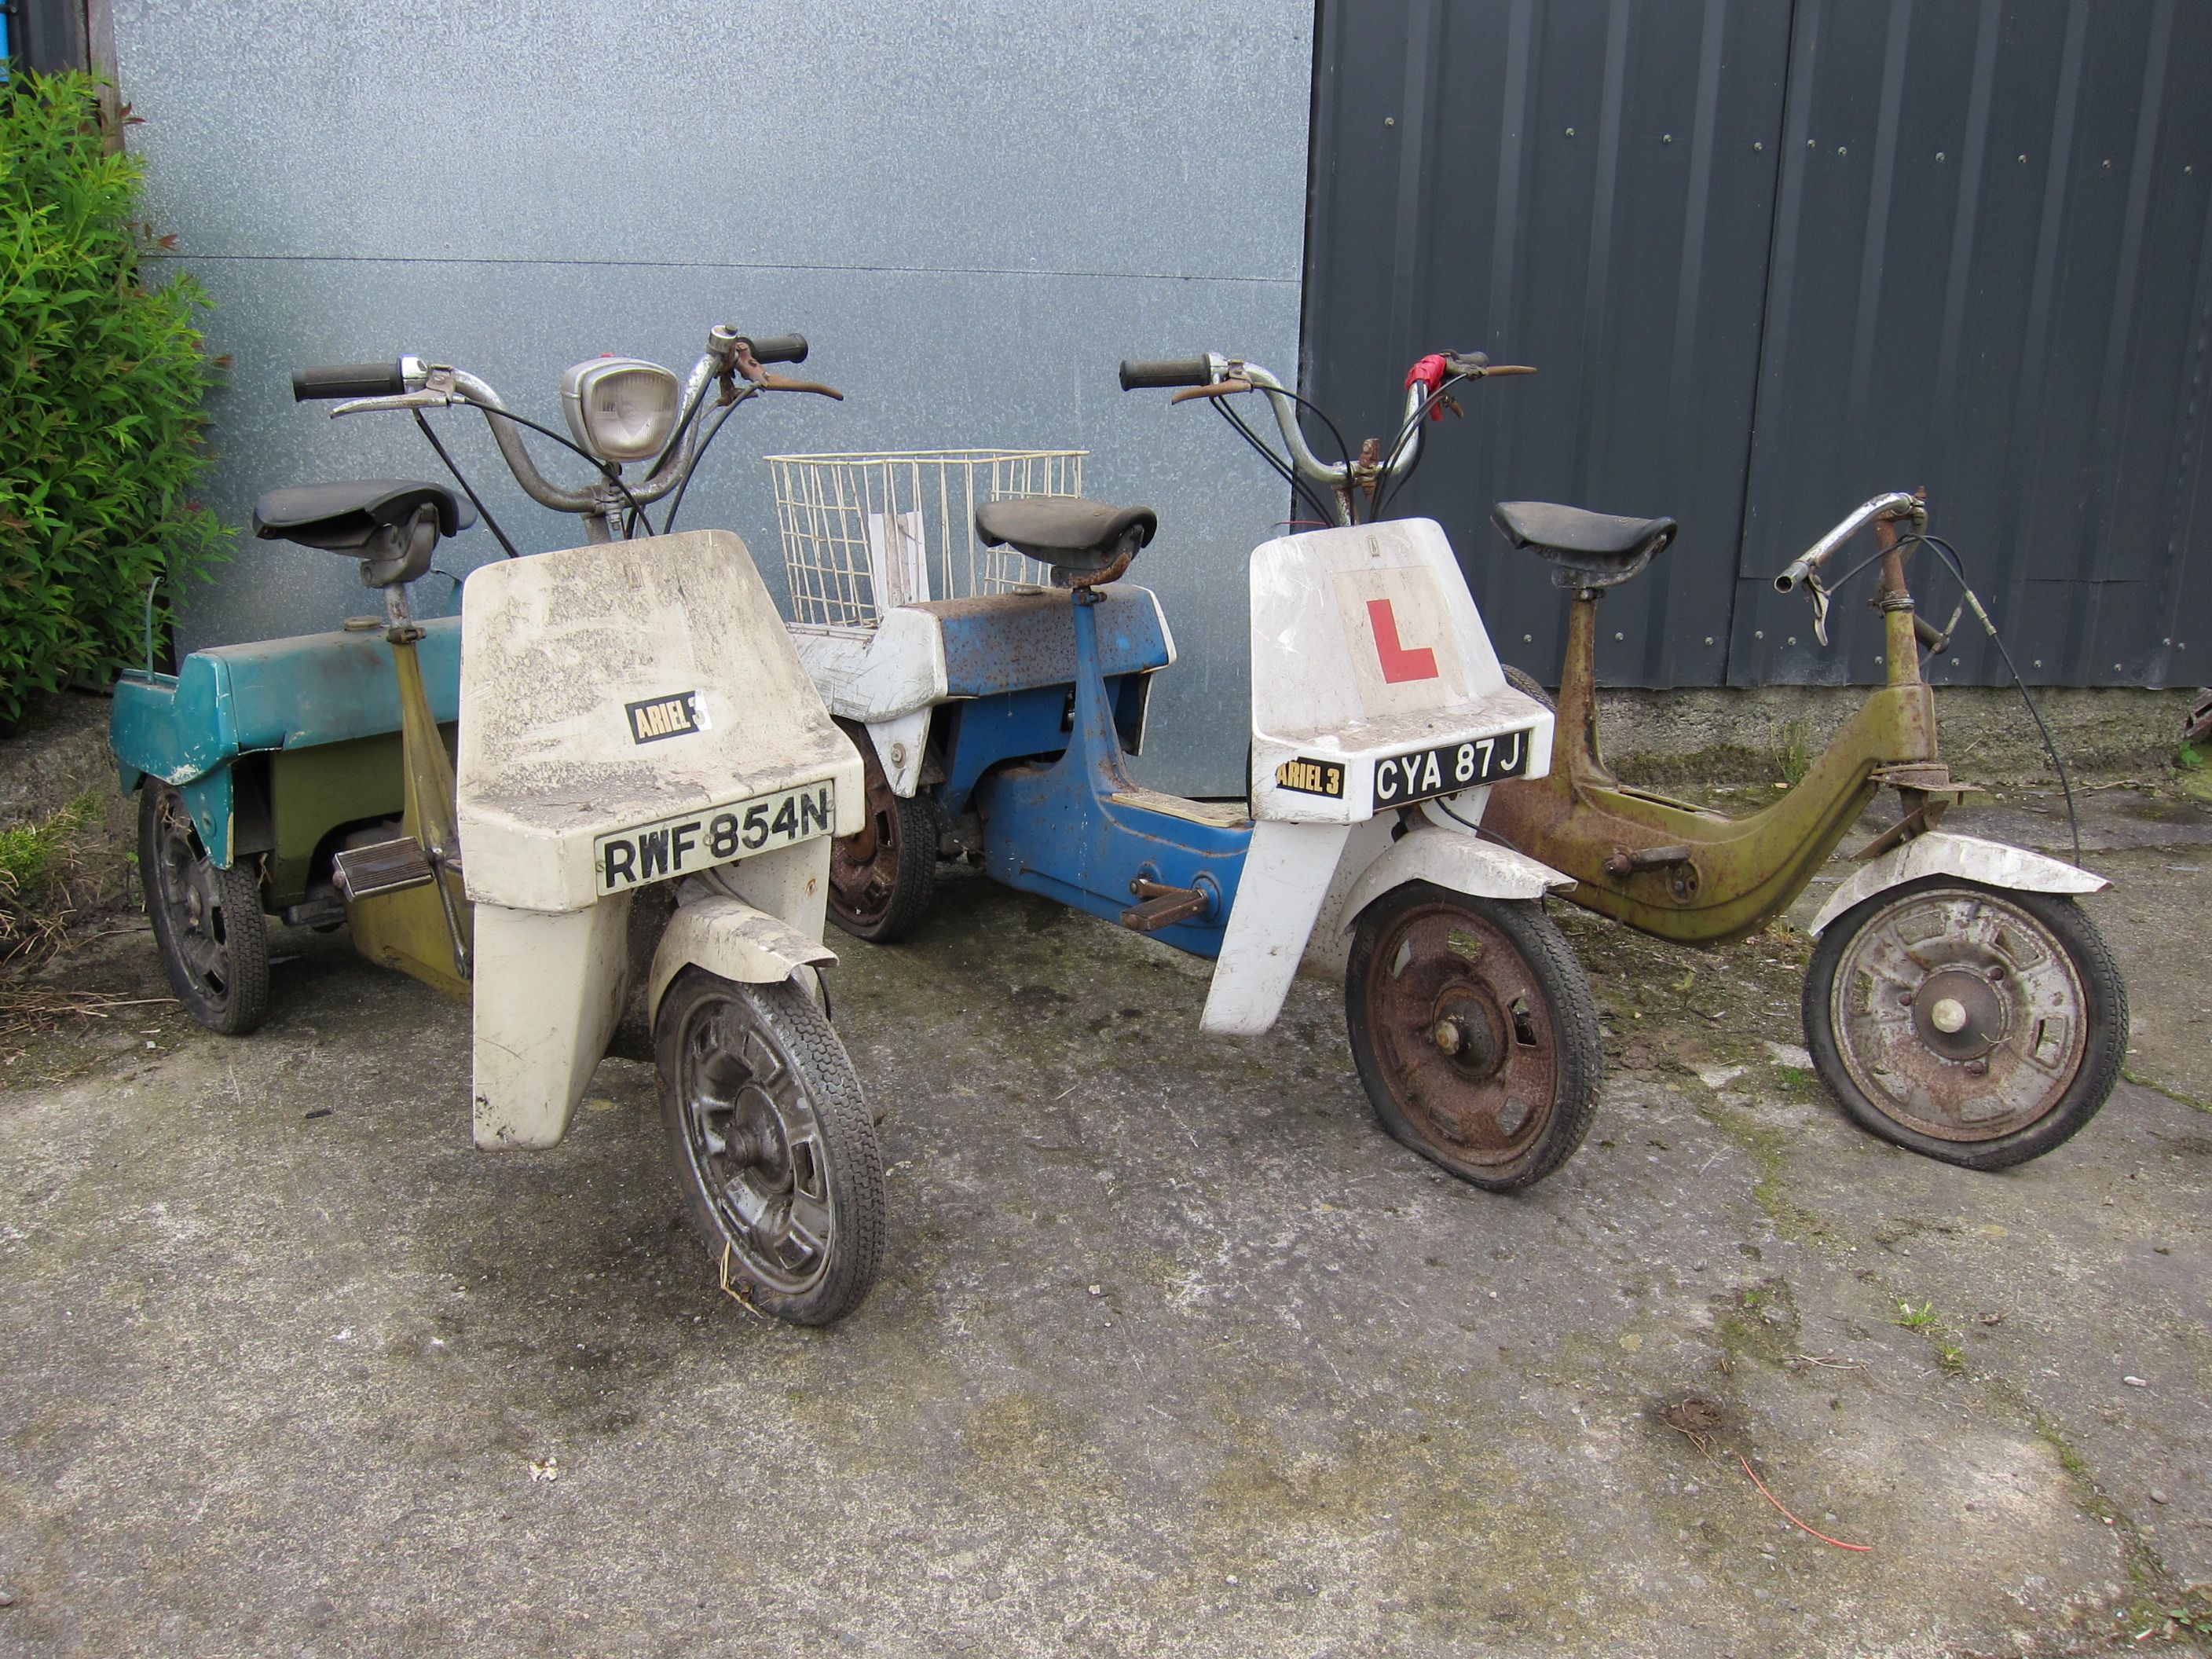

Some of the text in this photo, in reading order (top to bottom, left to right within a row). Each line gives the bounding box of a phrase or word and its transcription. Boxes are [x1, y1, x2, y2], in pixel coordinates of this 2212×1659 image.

[1366, 599, 1439, 684] L
[635, 699, 691, 738] ARIEL
[1276, 760, 1340, 795] ARIEL 3
[1377, 751, 1441, 800] CYA
[604, 788, 829, 888] RWF 854N
